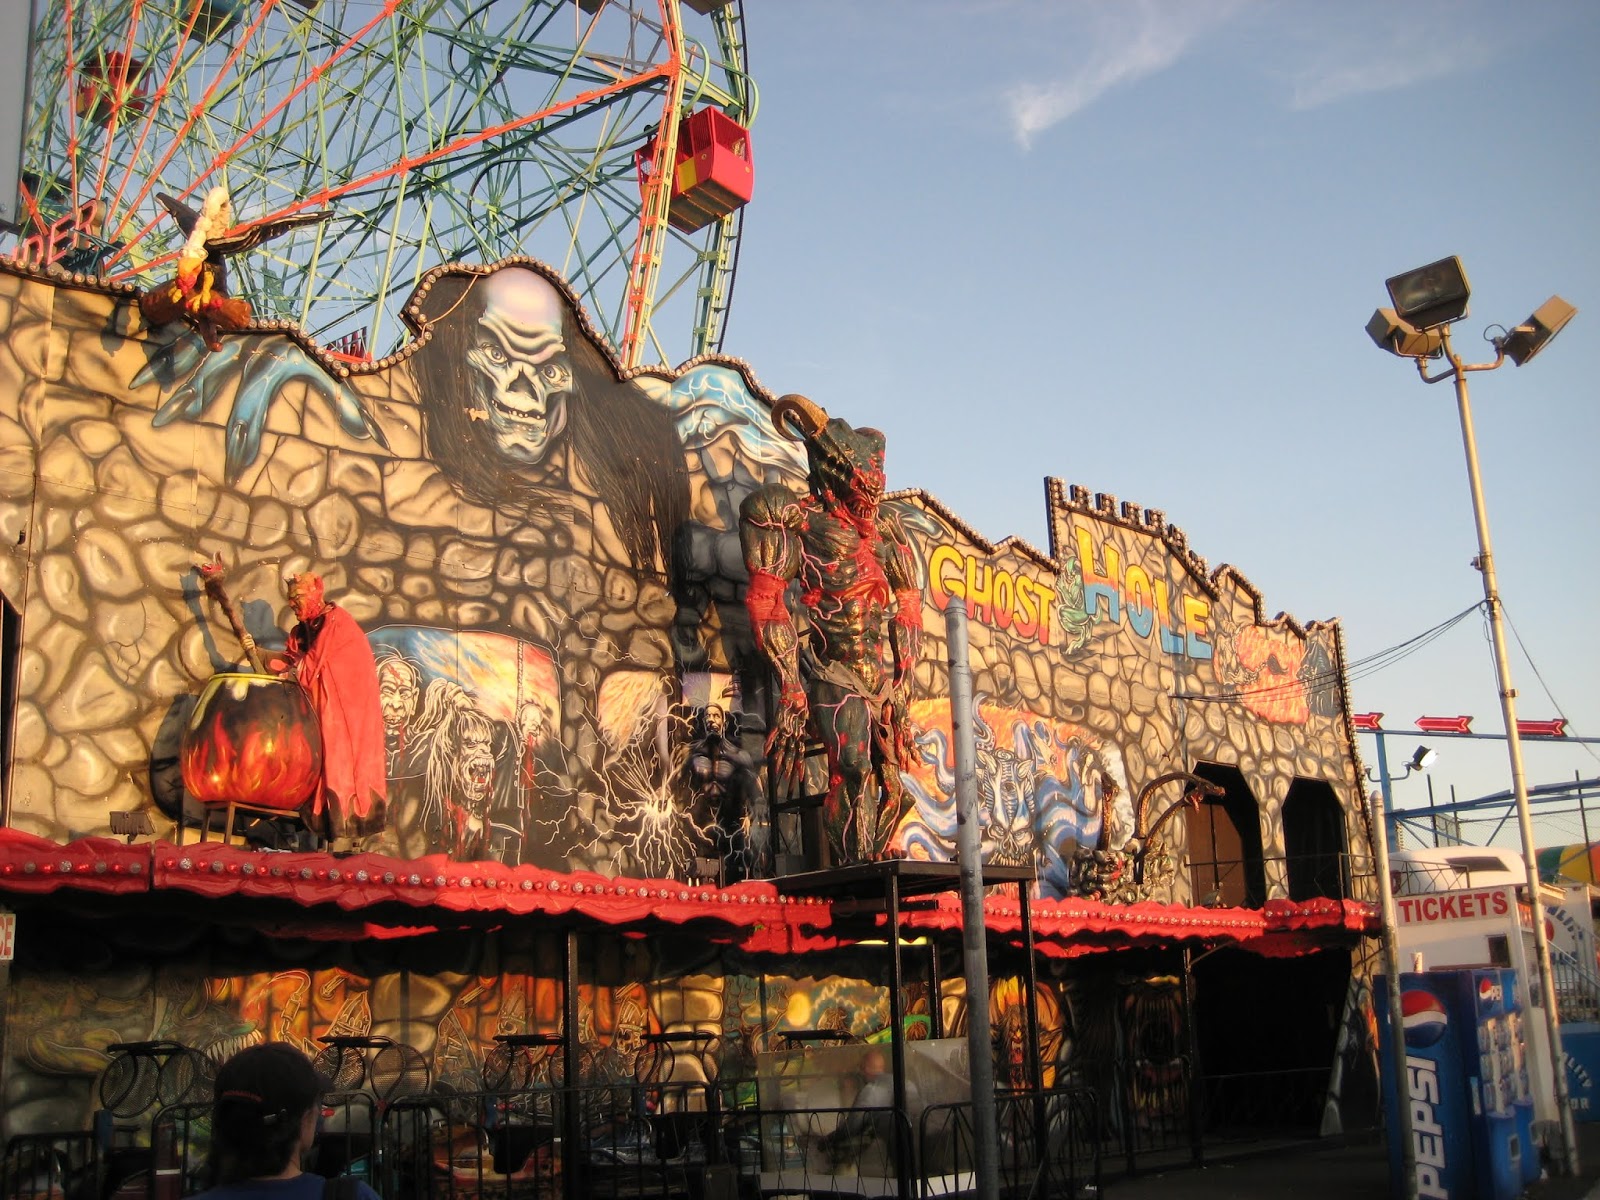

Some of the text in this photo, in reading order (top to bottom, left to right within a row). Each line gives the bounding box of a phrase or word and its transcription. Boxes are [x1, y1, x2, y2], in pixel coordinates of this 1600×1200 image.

[929, 525, 1213, 660] GHOST HOLE
[1398, 891, 1508, 922] TICKETS
[1406, 1056, 1449, 1200] PEPSI
